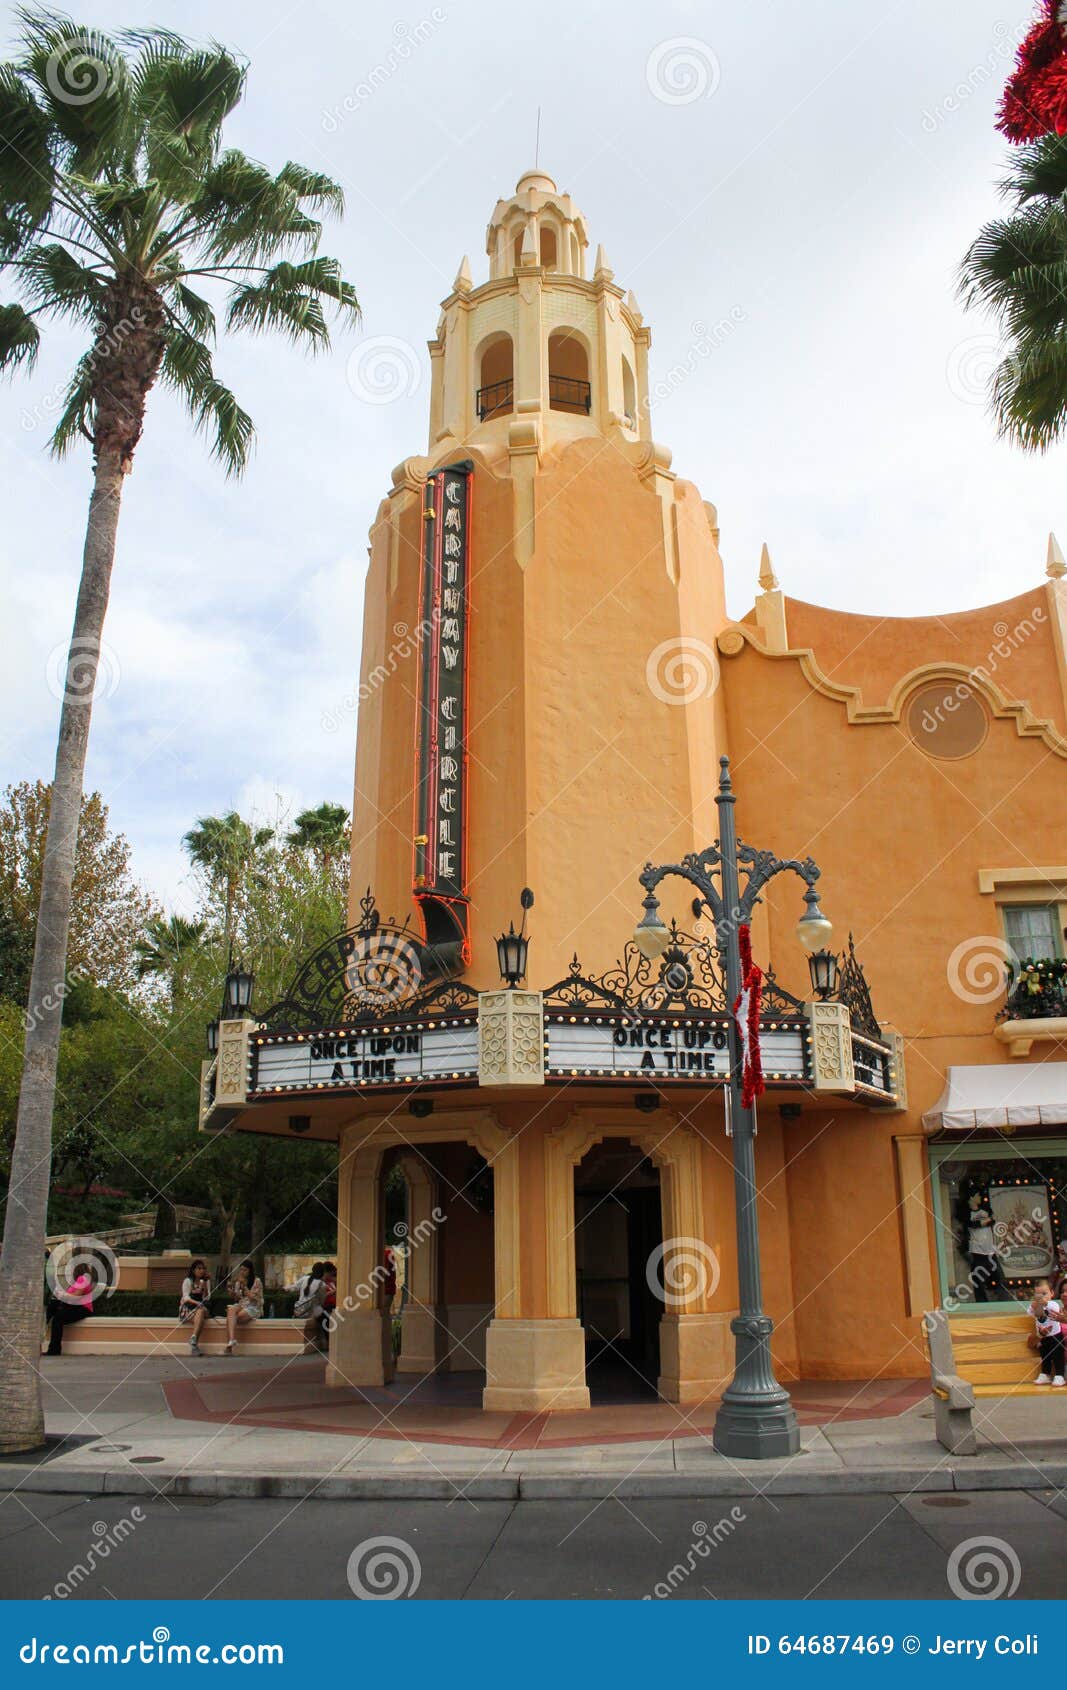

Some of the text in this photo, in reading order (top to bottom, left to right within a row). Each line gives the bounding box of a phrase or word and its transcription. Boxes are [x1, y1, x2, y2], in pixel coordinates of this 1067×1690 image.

[439, 481, 462, 879] CARTHAY CIRCLE
[310, 1035, 419, 1060] ONCE UPON
[612, 1028, 727, 1050] ONCE UPO
[331, 1058, 396, 1080] A TIME
[640, 1051, 716, 1070] A TIME
